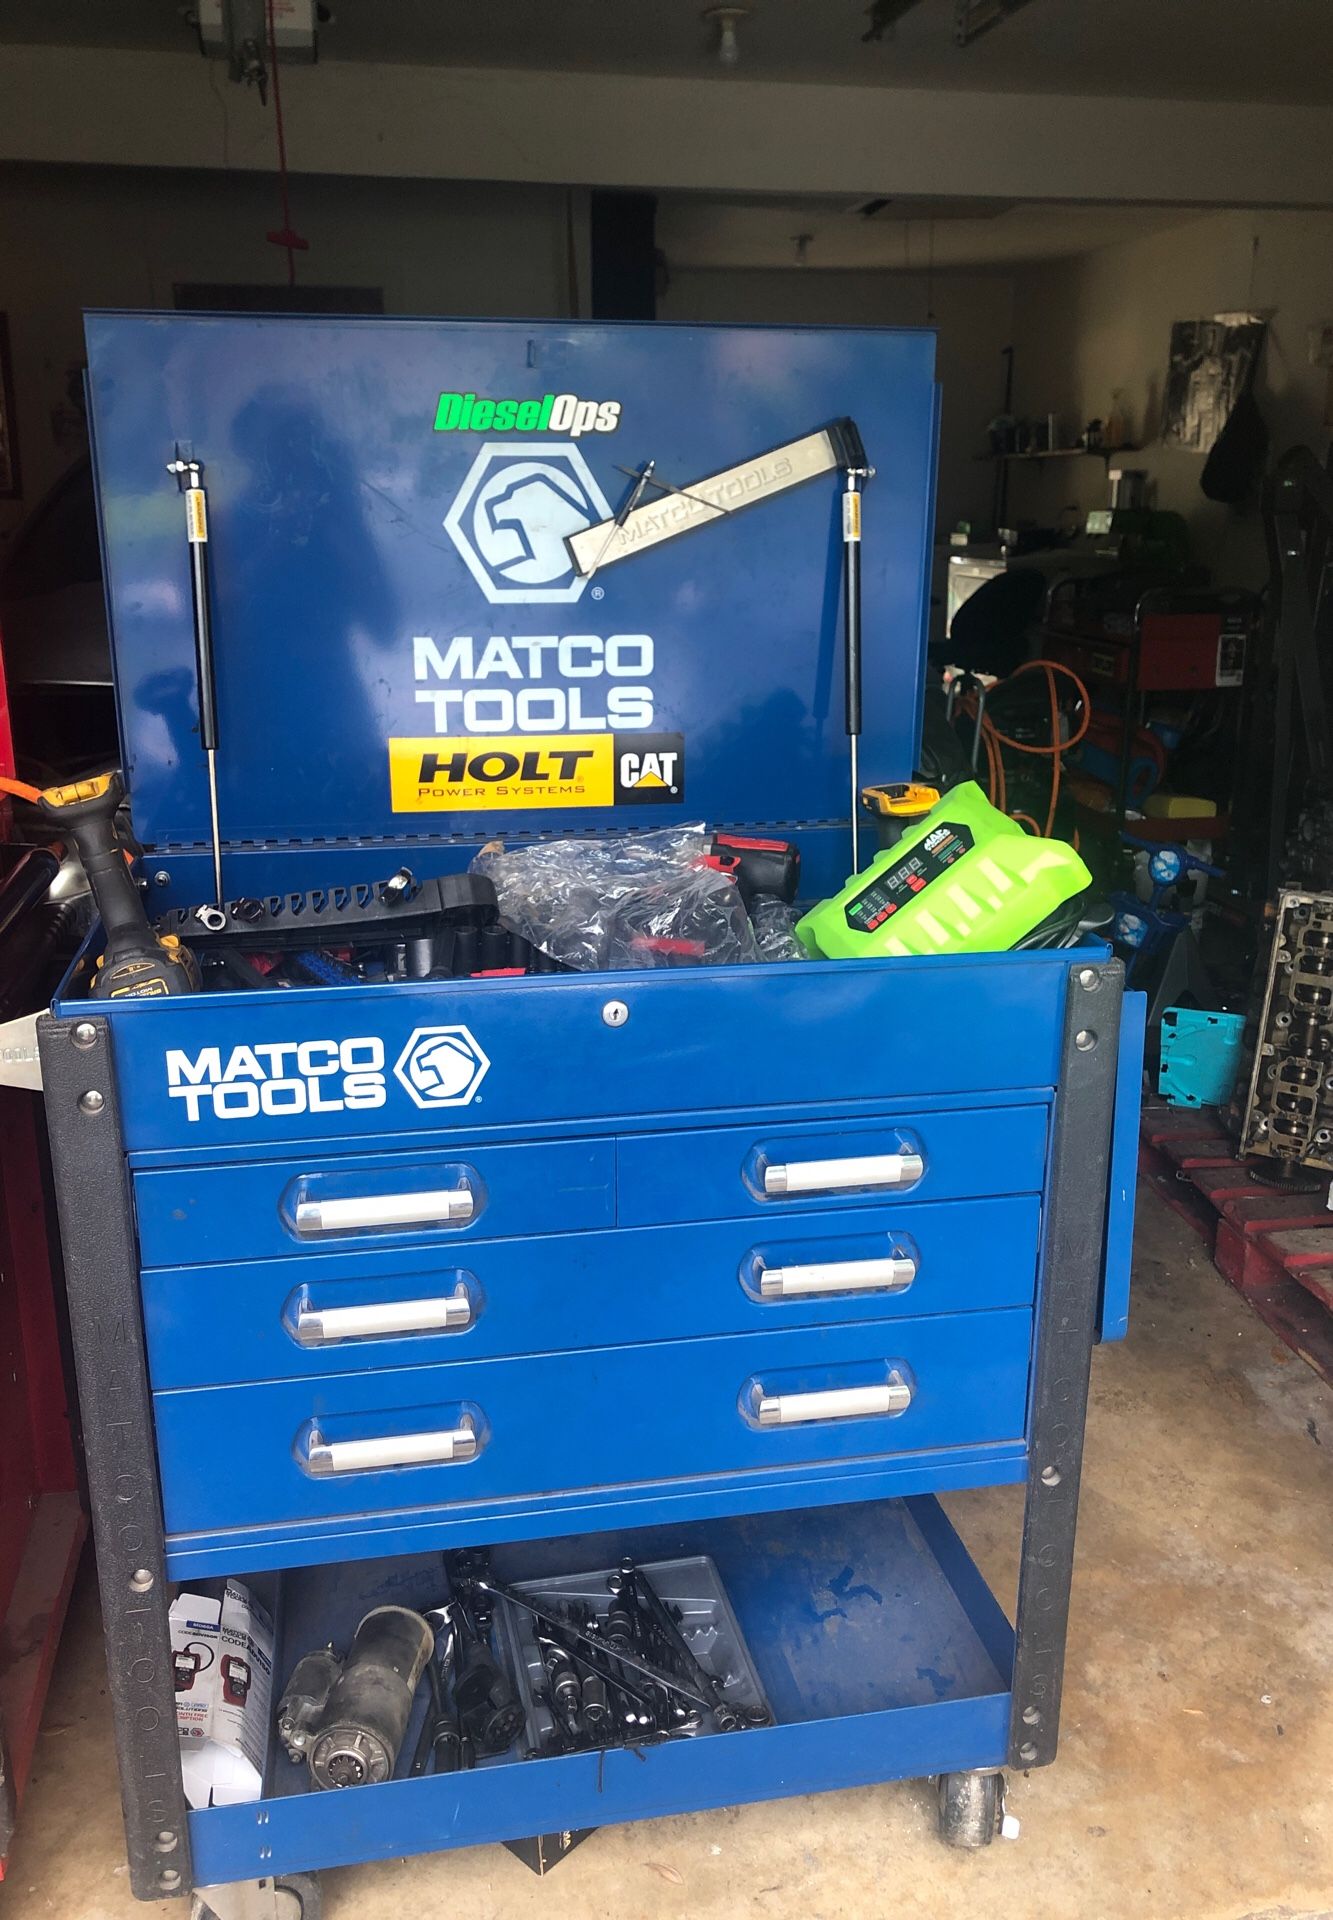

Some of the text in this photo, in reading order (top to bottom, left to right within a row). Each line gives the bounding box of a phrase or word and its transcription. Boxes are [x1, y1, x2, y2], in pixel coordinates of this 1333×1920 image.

[434, 393, 622, 437] DieselOps
[709, 457, 793, 506] TOOLS
[412, 634, 654, 680] MATCO
[415, 686, 654, 733] TOOLS
[418, 750, 594, 783] HOLT
[620, 752, 678, 788] CAT
[165, 1036, 385, 1086] MATCO
[168, 1072, 387, 1122] TOOLS
